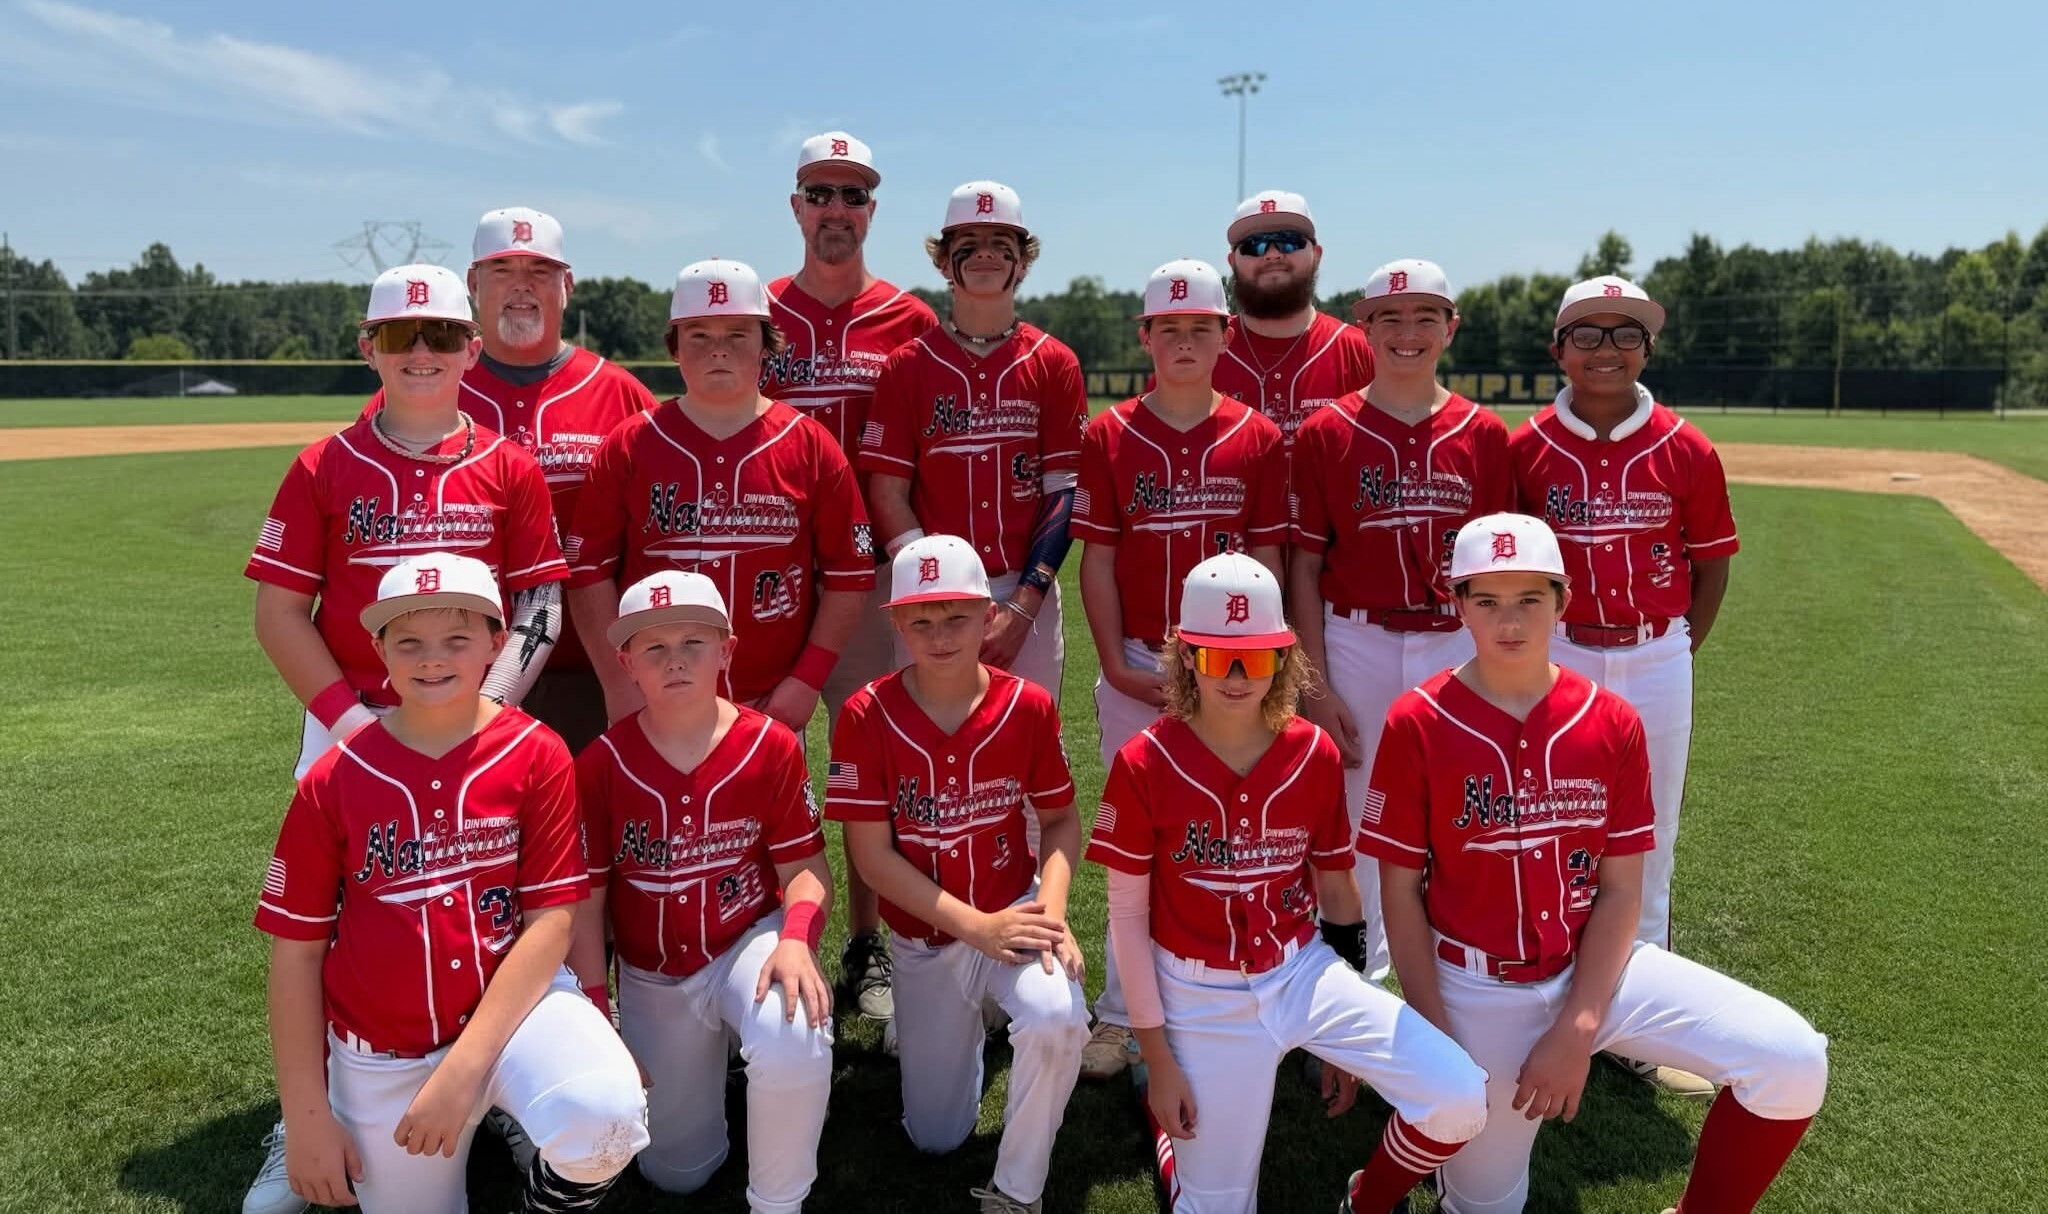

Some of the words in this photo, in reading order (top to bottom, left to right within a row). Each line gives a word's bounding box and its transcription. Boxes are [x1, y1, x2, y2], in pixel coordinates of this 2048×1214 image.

[831, 139, 849, 157] D
[976, 192, 995, 216] D
[513, 220, 534, 244] D
[406, 279, 430, 308] D
[707, 281, 729, 308] D
[1169, 279, 1189, 304] D
[1388, 271, 1408, 295] D
[1437, 373, 1571, 400] MPLE
[343, 496, 494, 544] Nationals
[642, 483, 800, 534] Nationals
[1491, 532, 1518, 562] D
[416, 568, 442, 595] D
[918, 557, 940, 587] D
[649, 585, 672, 609] D
[1225, 591, 1250, 627] D
[1554, 778, 1593, 790] DINWIDDIE
[1453, 774, 1608, 830] Nationals
